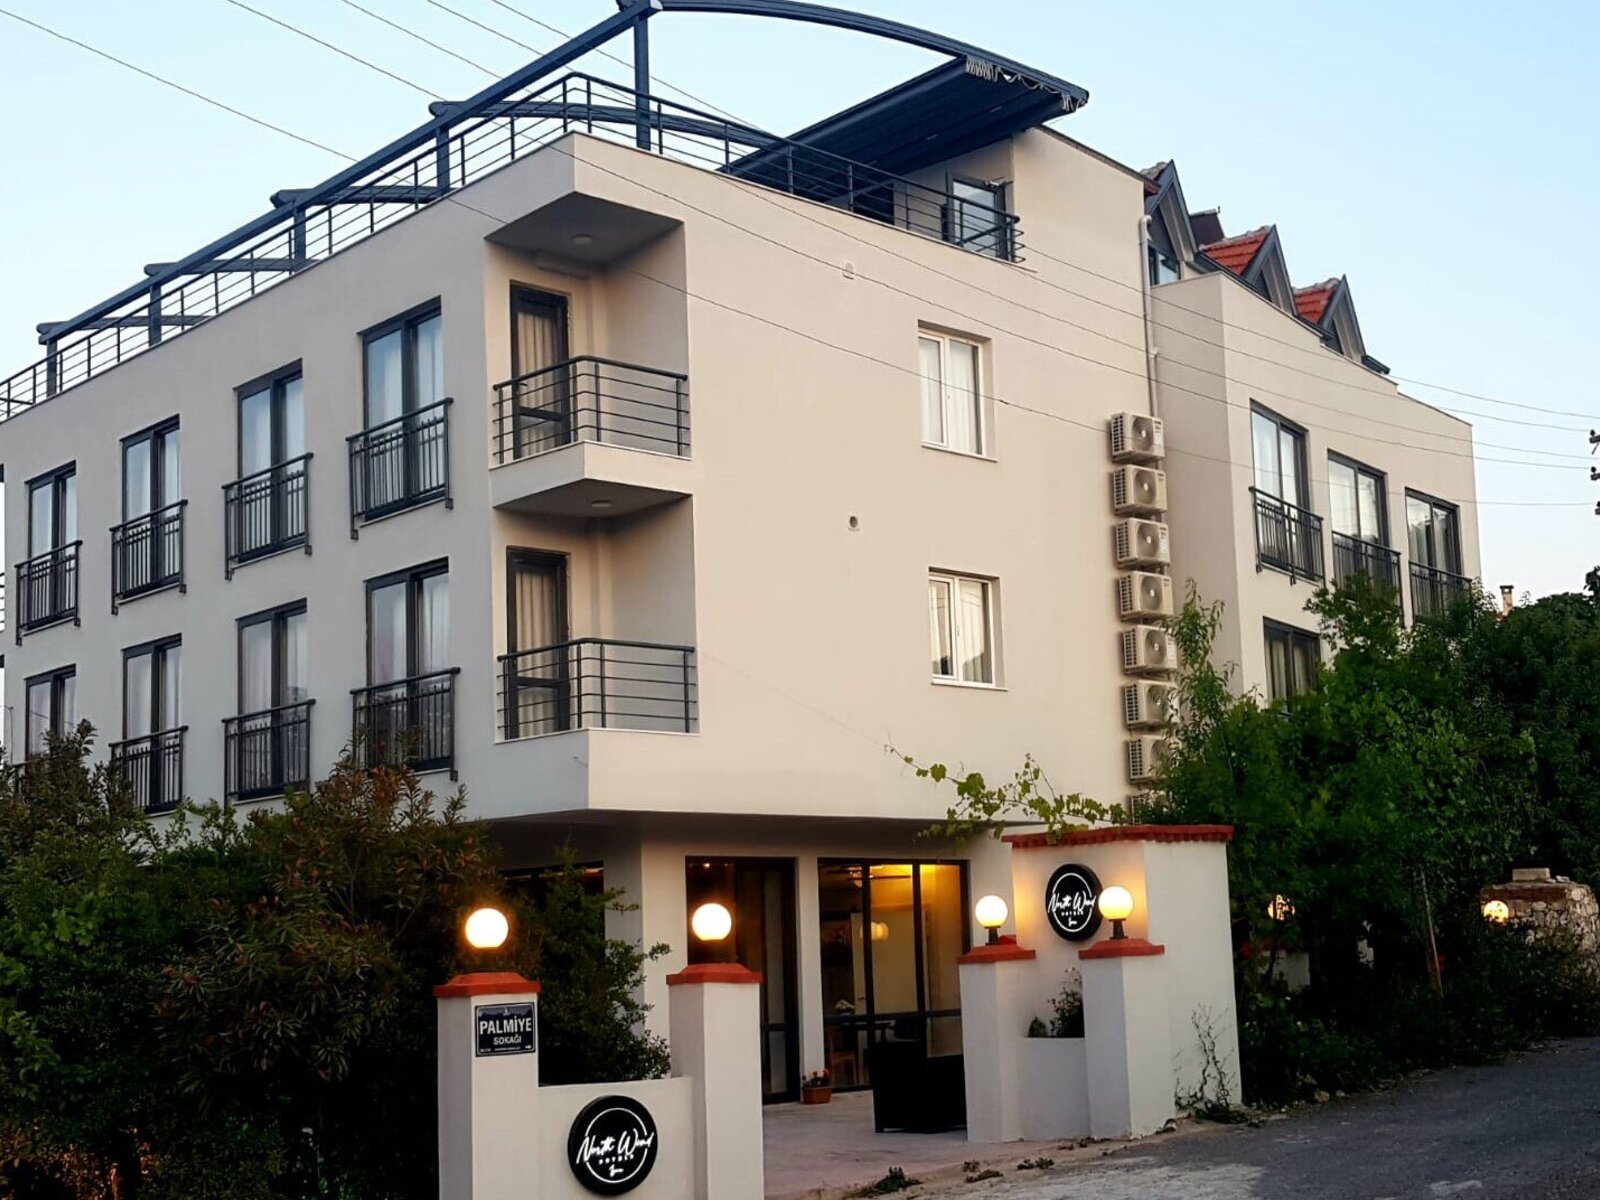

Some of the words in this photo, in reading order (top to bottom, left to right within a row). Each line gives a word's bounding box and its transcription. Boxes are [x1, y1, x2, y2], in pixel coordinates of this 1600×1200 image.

[479, 1015, 532, 1035] PALMİYE
[493, 1034, 522, 1046] SOKAĞI
[576, 1134, 616, 1165] North
[617, 1127, 655, 1156] Wind
